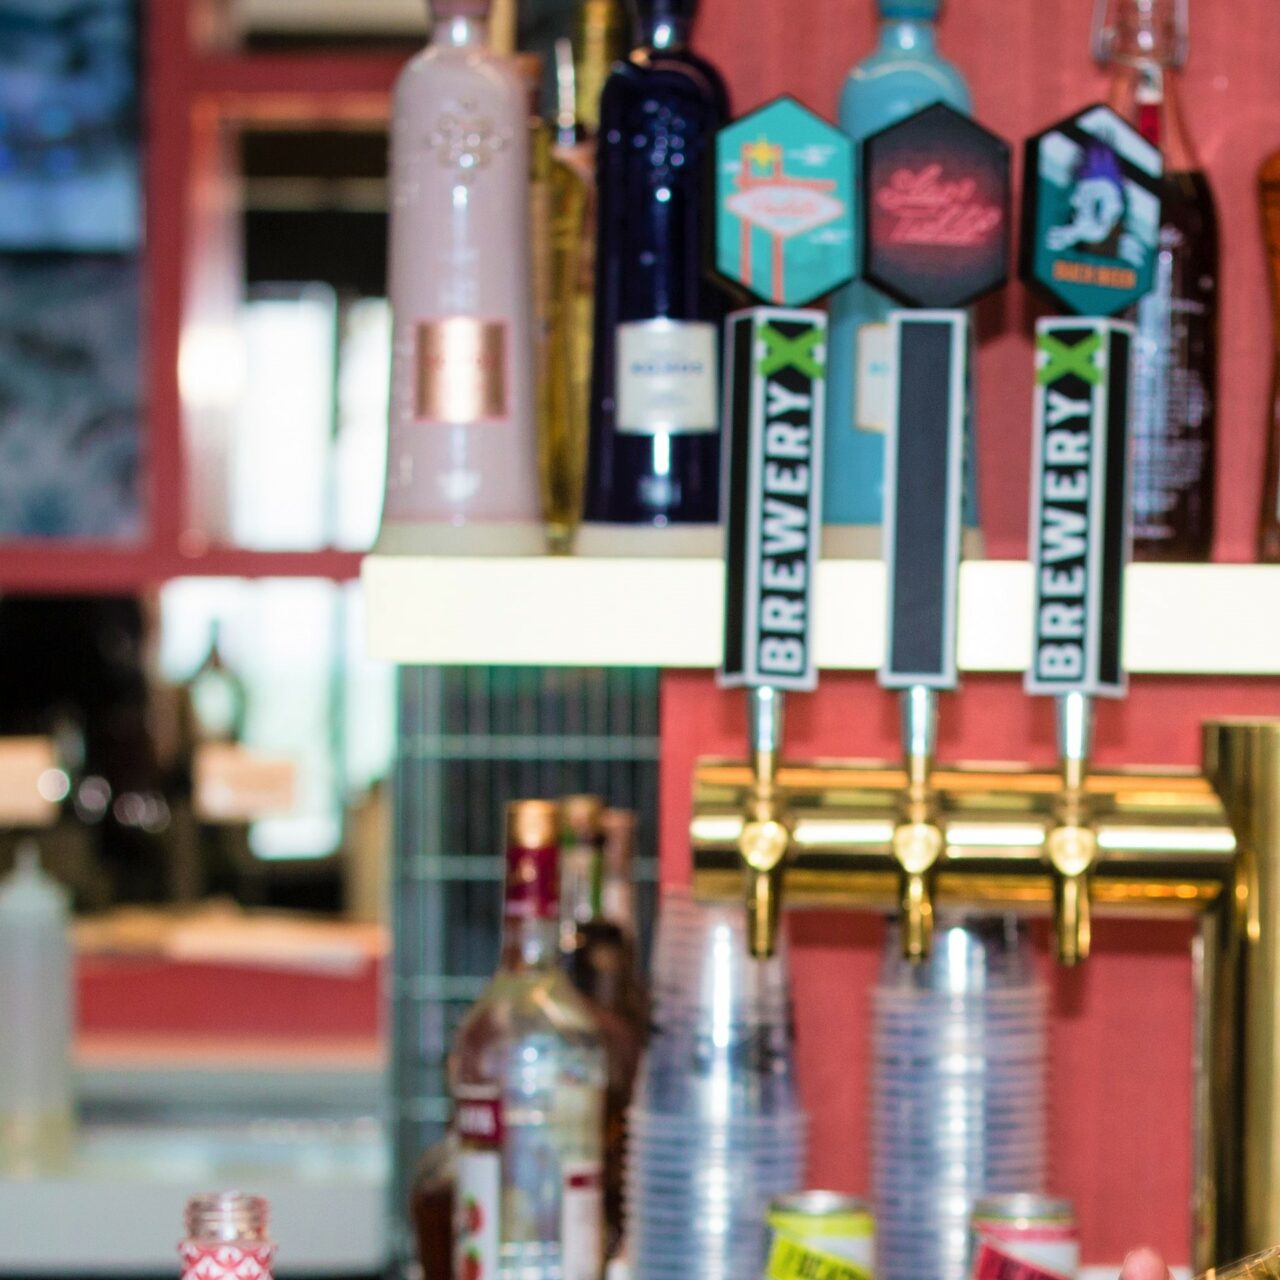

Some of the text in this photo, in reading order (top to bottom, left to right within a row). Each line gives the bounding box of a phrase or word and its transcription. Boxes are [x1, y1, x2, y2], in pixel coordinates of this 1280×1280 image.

[757, 323, 824, 676] BREWERY X
[1036, 331, 1103, 680] BREWERY X
